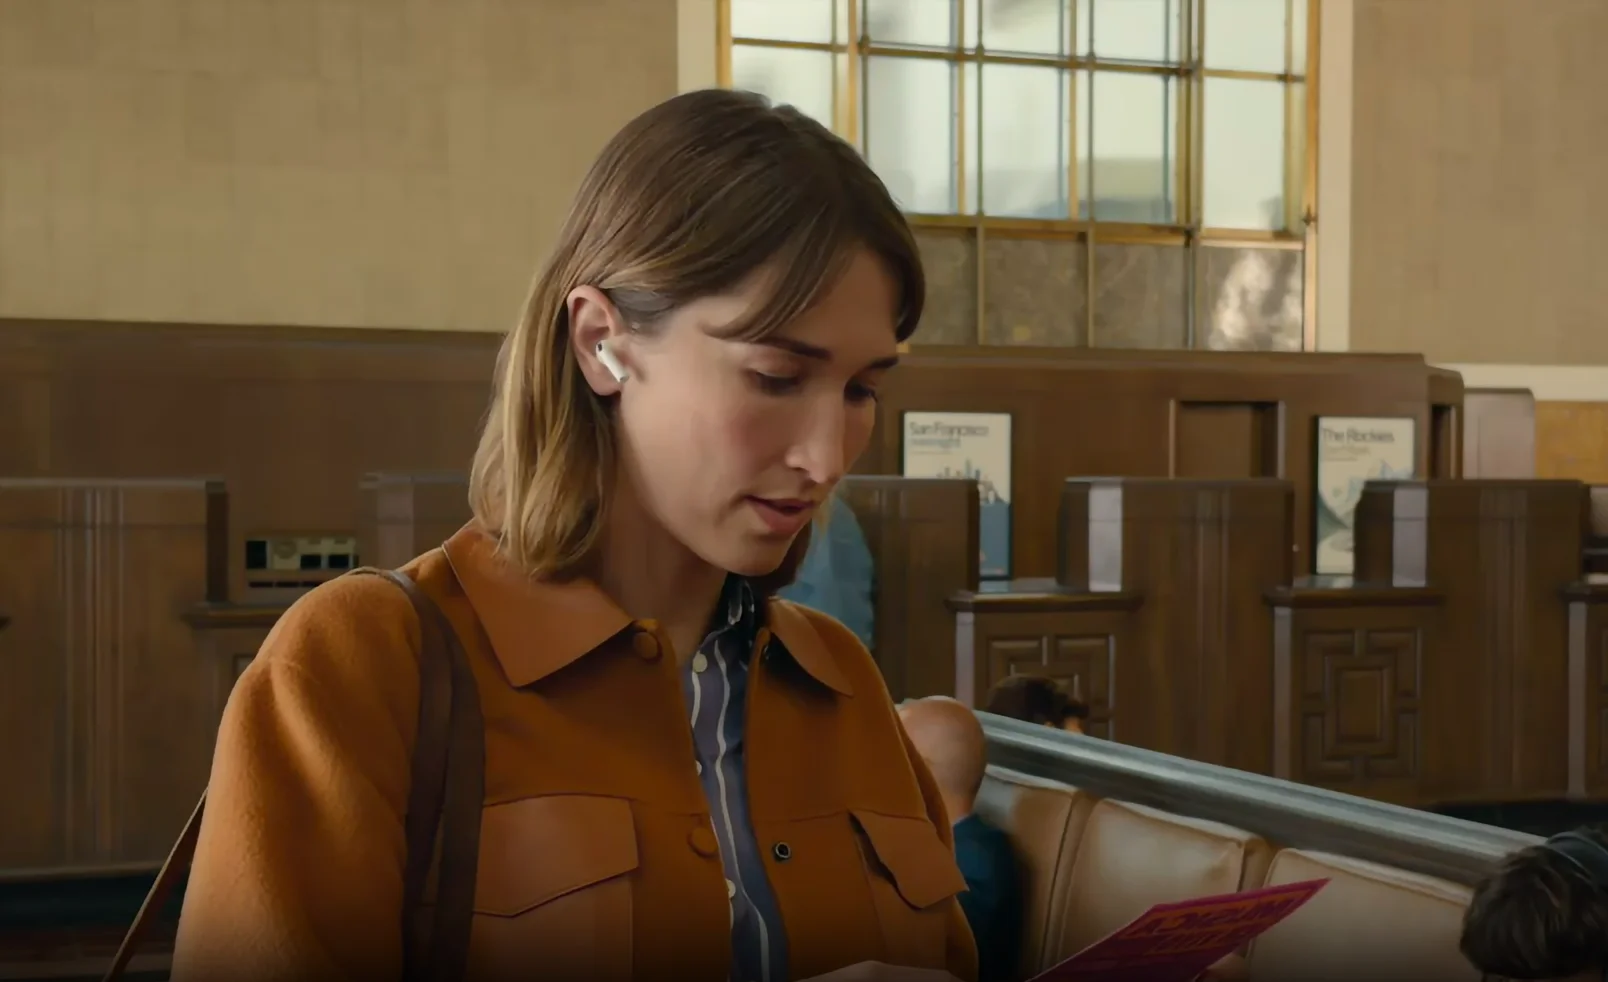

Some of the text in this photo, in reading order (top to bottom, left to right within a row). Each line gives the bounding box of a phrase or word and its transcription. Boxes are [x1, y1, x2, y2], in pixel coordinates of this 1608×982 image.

[909, 421, 989, 437] San Francisco
[1322, 427, 1395, 443] The Rockies
